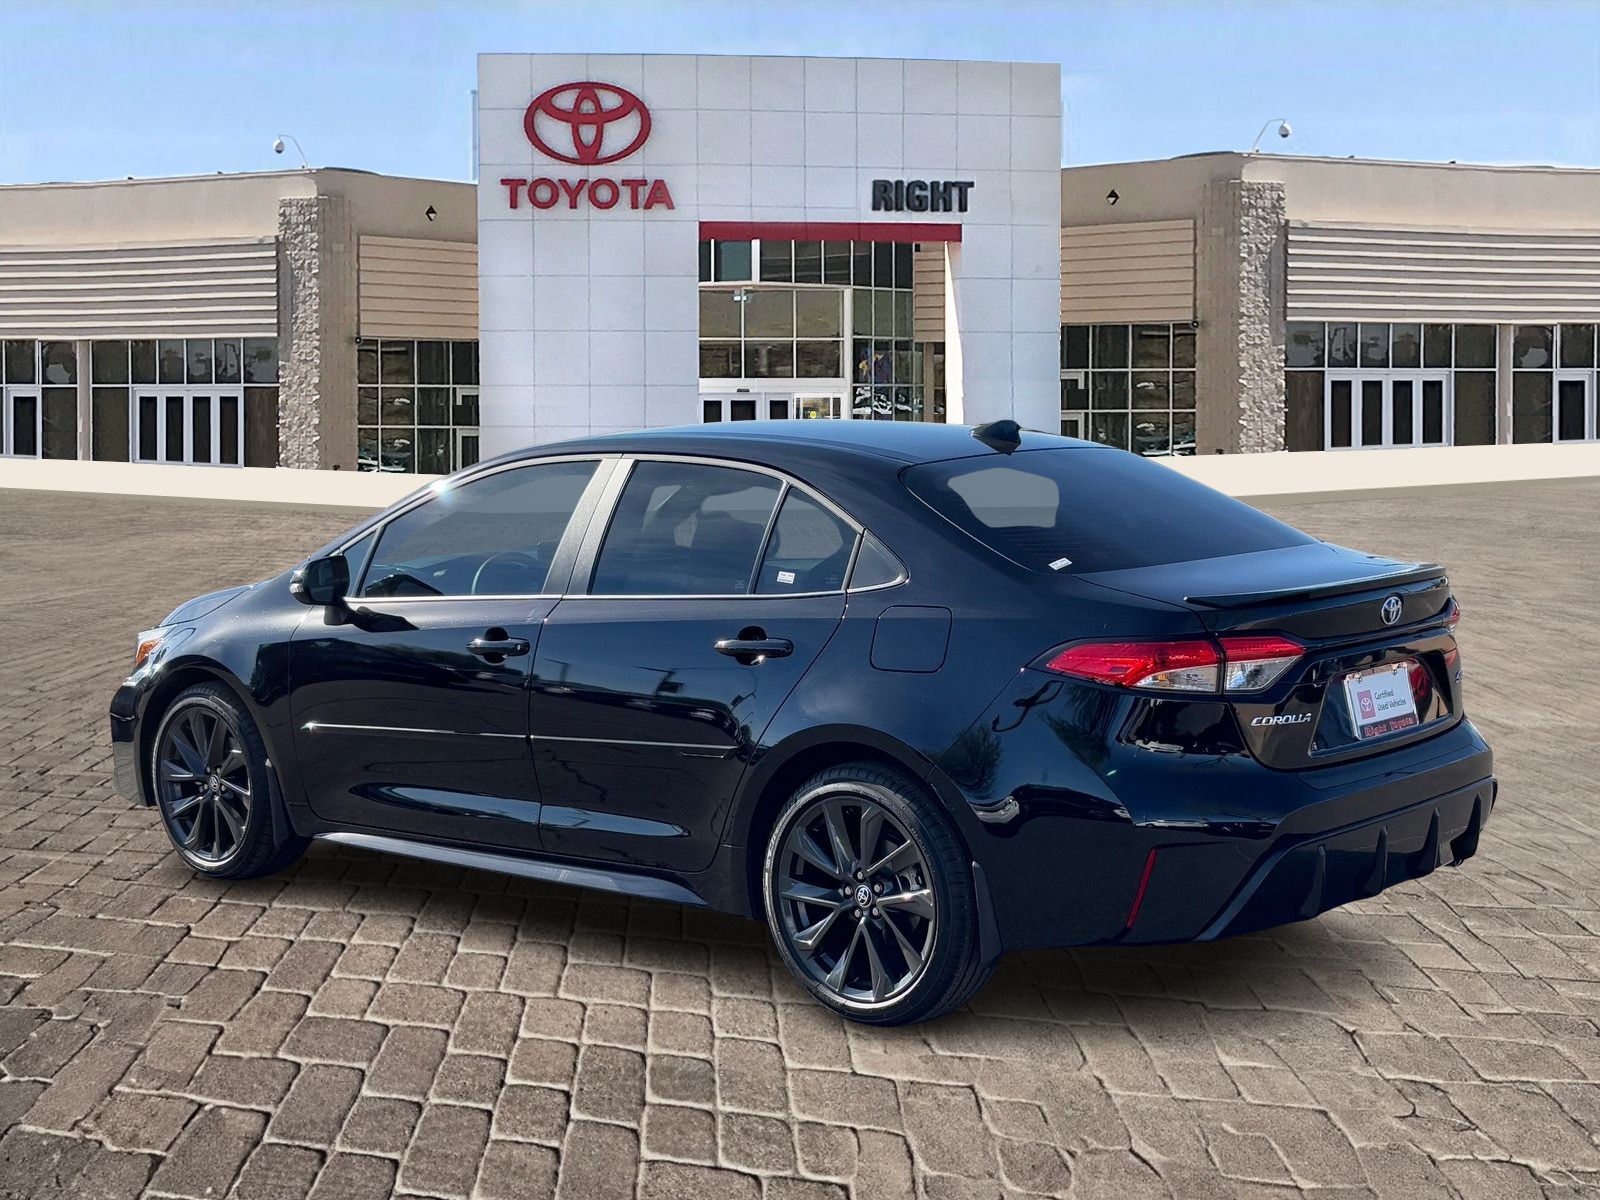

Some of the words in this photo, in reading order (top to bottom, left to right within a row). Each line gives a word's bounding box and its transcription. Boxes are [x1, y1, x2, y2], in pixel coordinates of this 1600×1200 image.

[500, 178, 675, 210] TOYOTA
[872, 180, 975, 212] RIGHT
[1374, 689, 1394, 700] Certified
[1377, 702, 1389, 711] Used
[1389, 699, 1407, 708] Vehicles
[1251, 713, 1312, 726] COROLLA
[1389, 718, 1414, 731] Toyota
